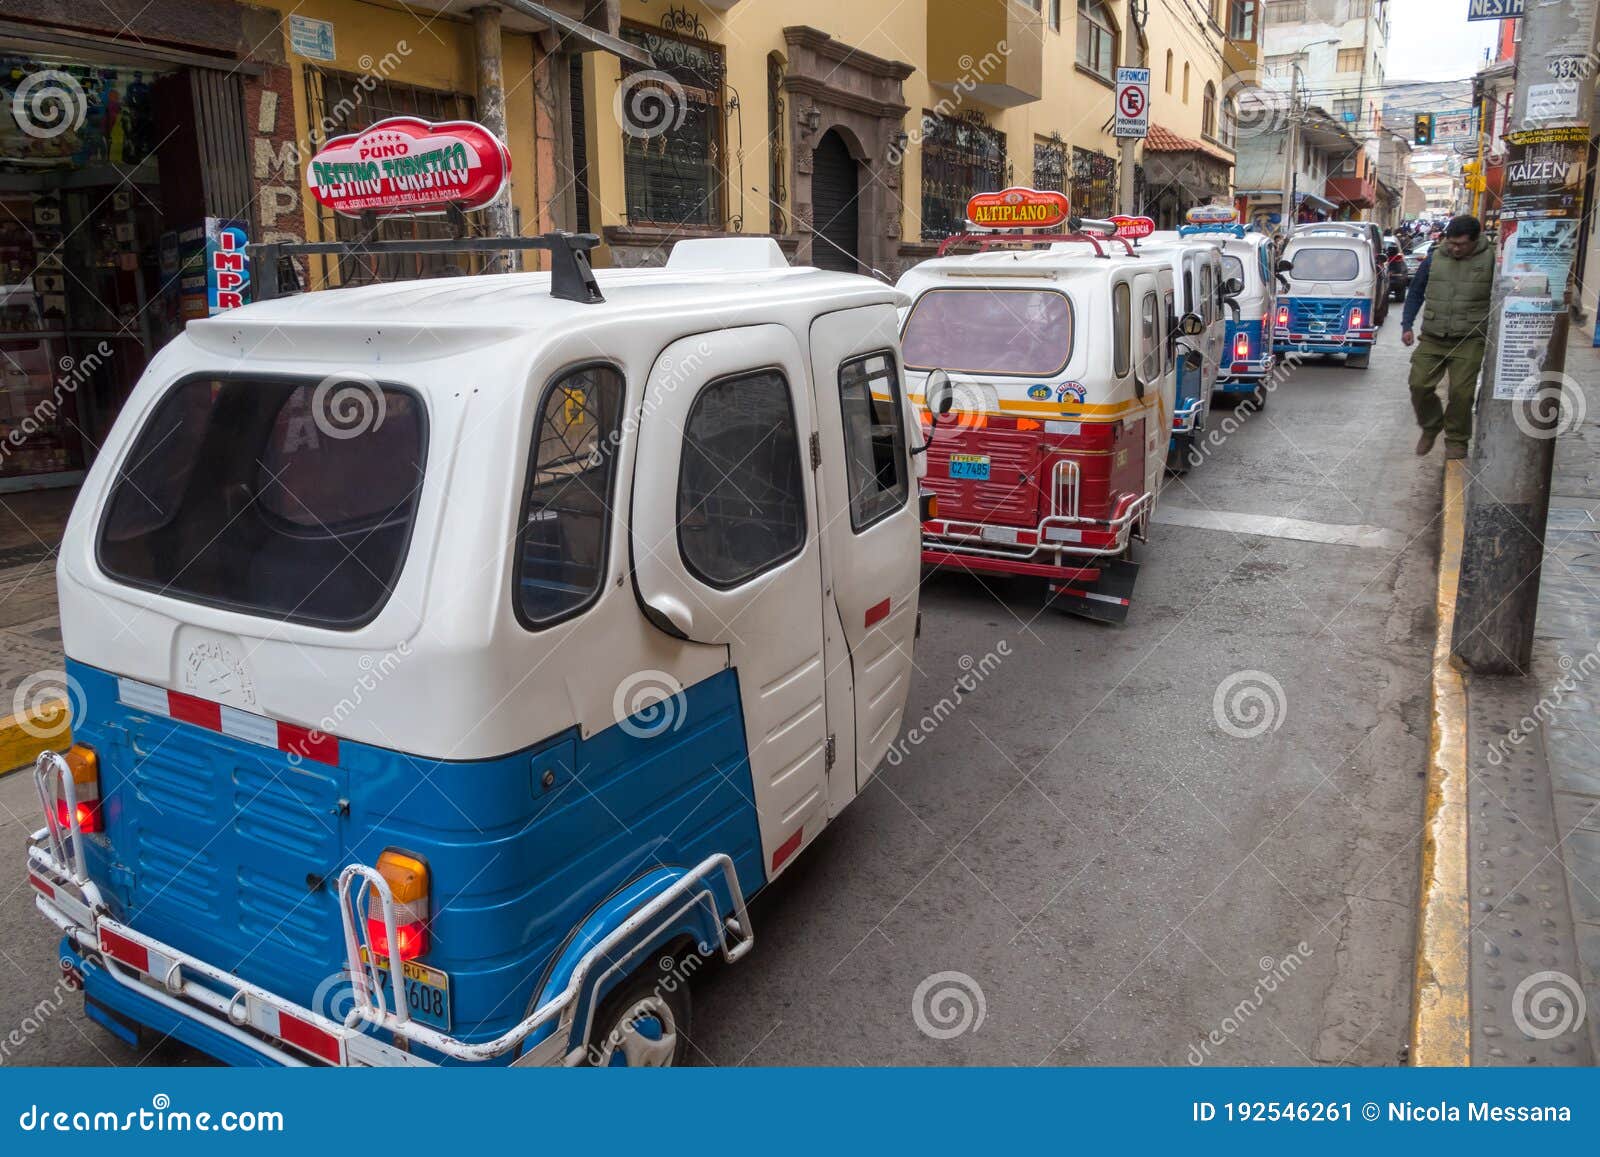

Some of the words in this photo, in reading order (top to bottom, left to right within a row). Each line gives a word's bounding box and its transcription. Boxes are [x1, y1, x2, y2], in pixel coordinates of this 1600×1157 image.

[1117, 118, 1146, 126] PROHIBIDO
[1116, 127, 1145, 135] ESTACIONAR
[359, 143, 409, 160] PUNO
[312, 160, 381, 199] DESTINO
[383, 142, 469, 192] TURISTICO
[1508, 162, 1566, 182] KAIZEN
[975, 204, 1047, 222] ALTIPLANO
